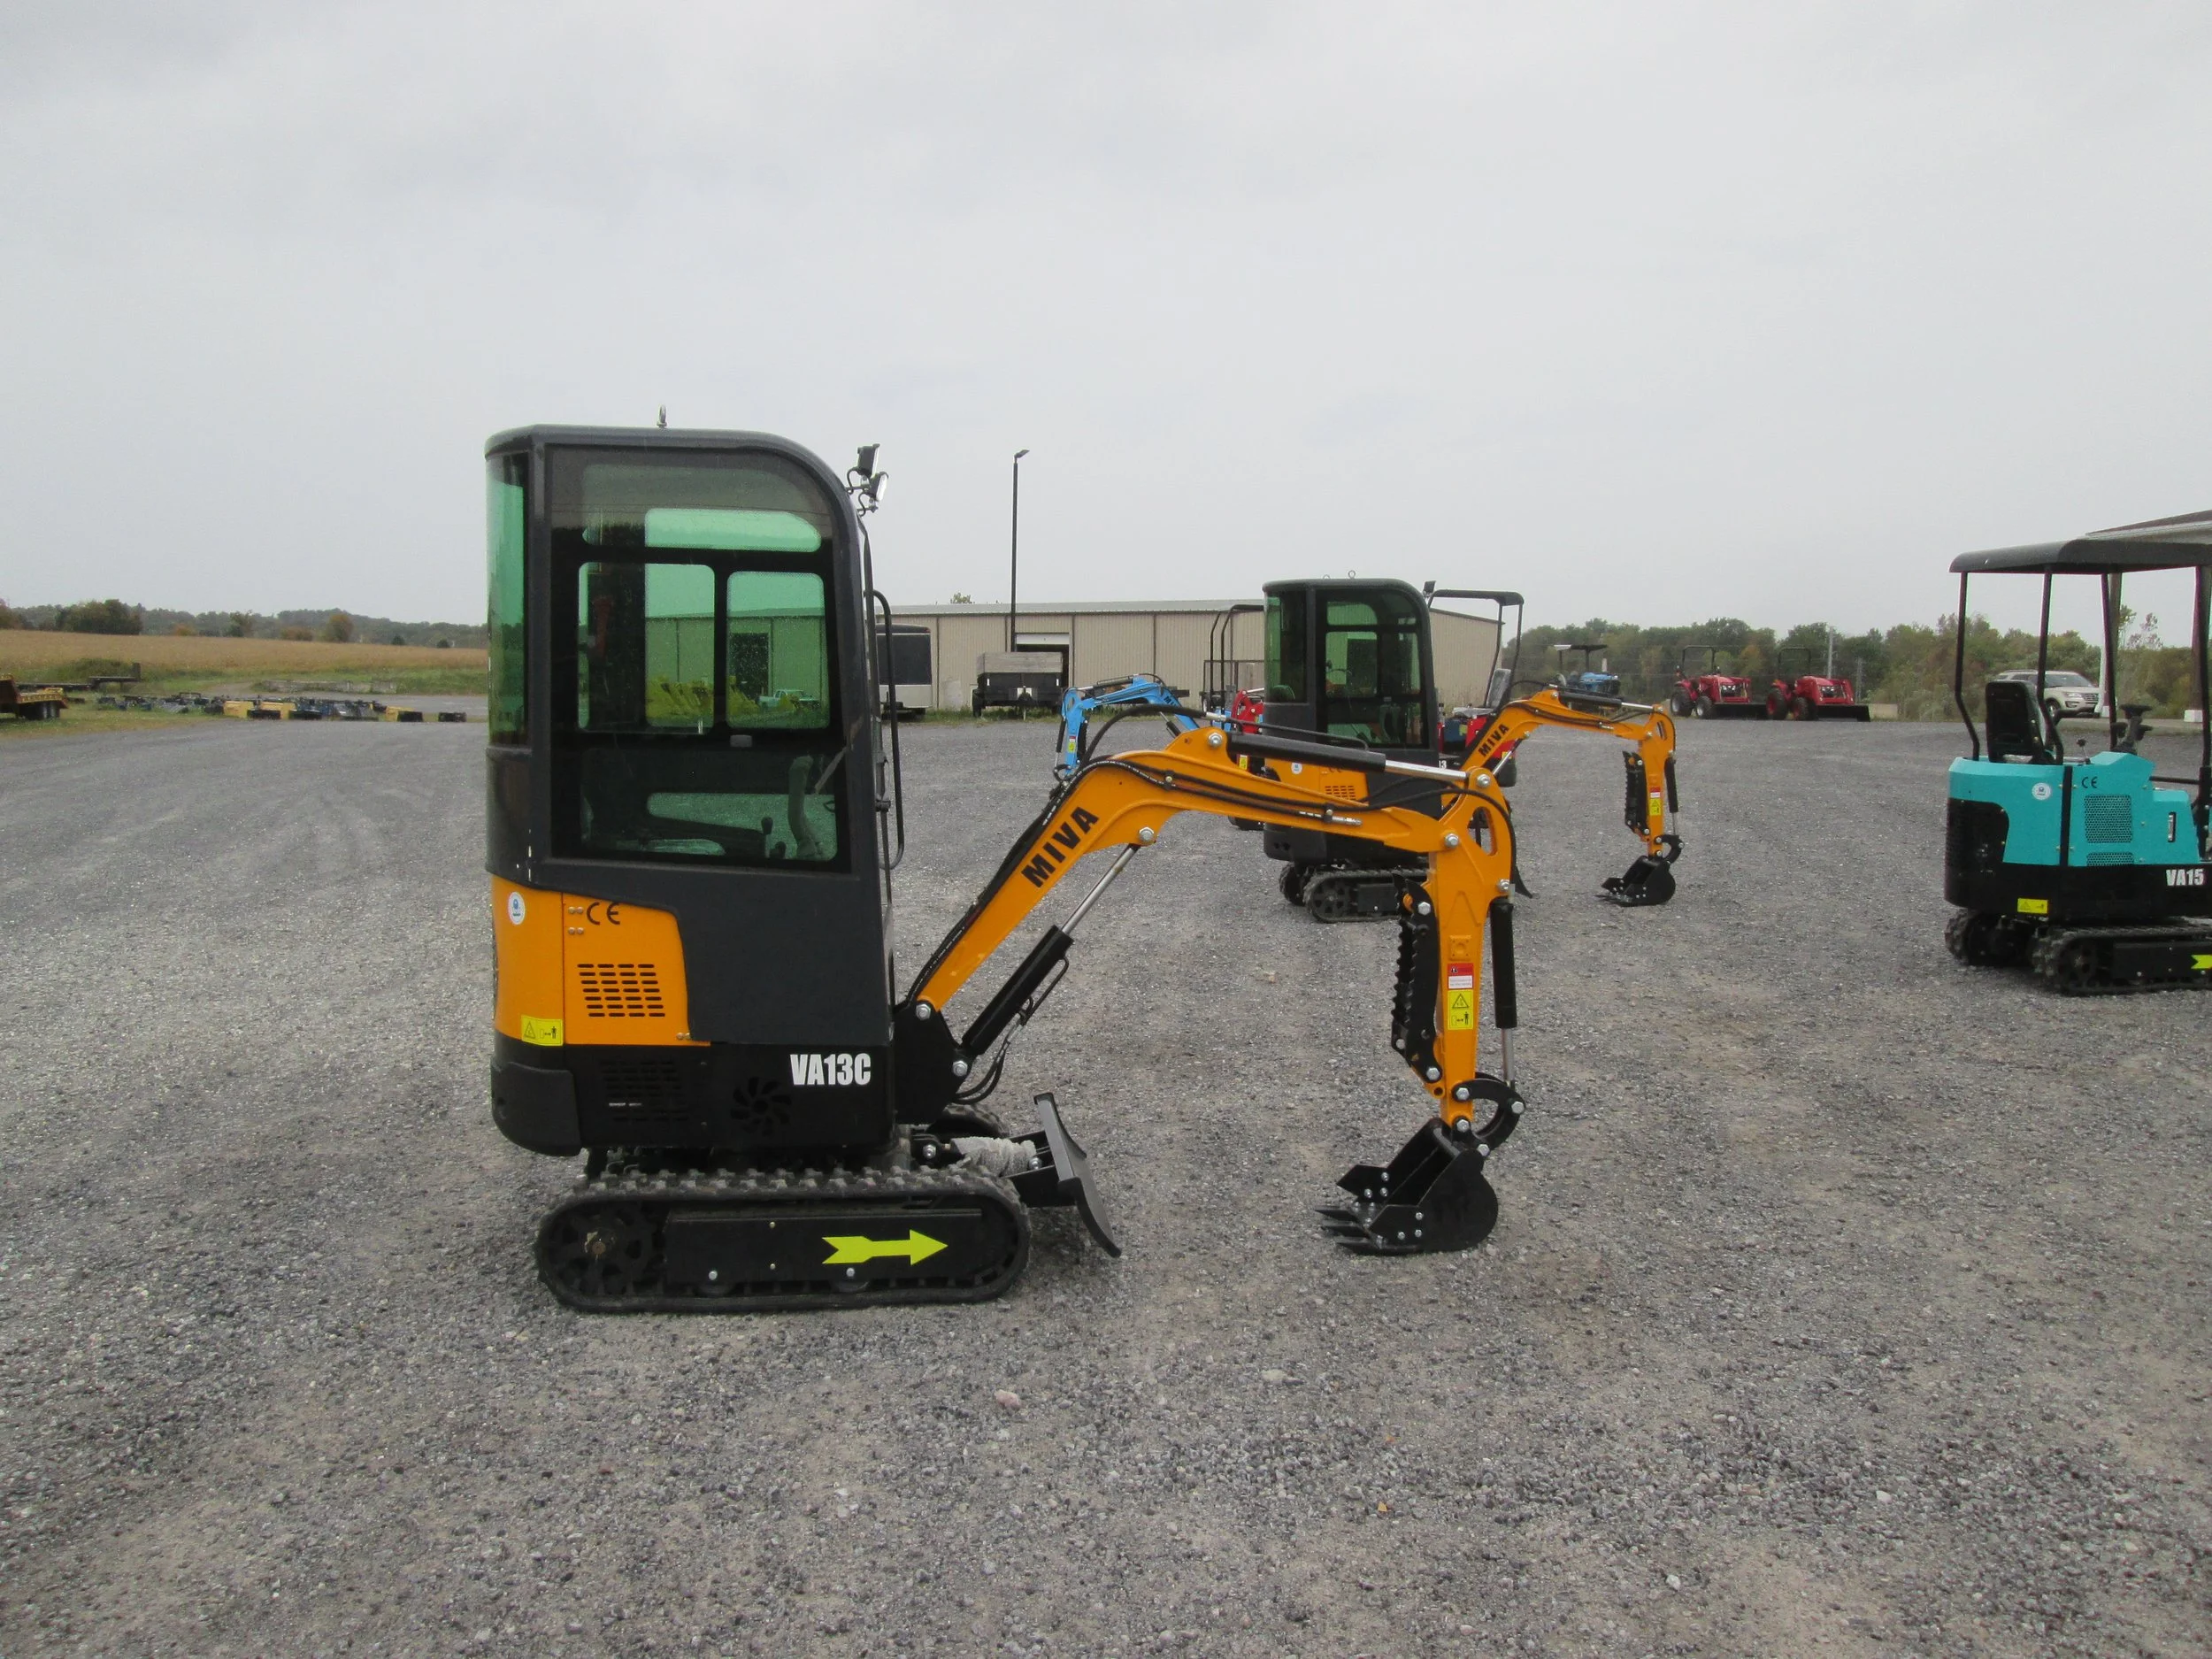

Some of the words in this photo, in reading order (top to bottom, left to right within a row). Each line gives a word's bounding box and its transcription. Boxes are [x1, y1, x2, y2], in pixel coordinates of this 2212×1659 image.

[1479, 724, 1509, 757] MIVA
[2081, 776, 2098, 788] CE
[1021, 806, 1099, 887] MIVA
[2166, 868, 2204, 886] VA15
[587, 902, 620, 926] CE
[789, 1053, 871, 1086] VA13C
